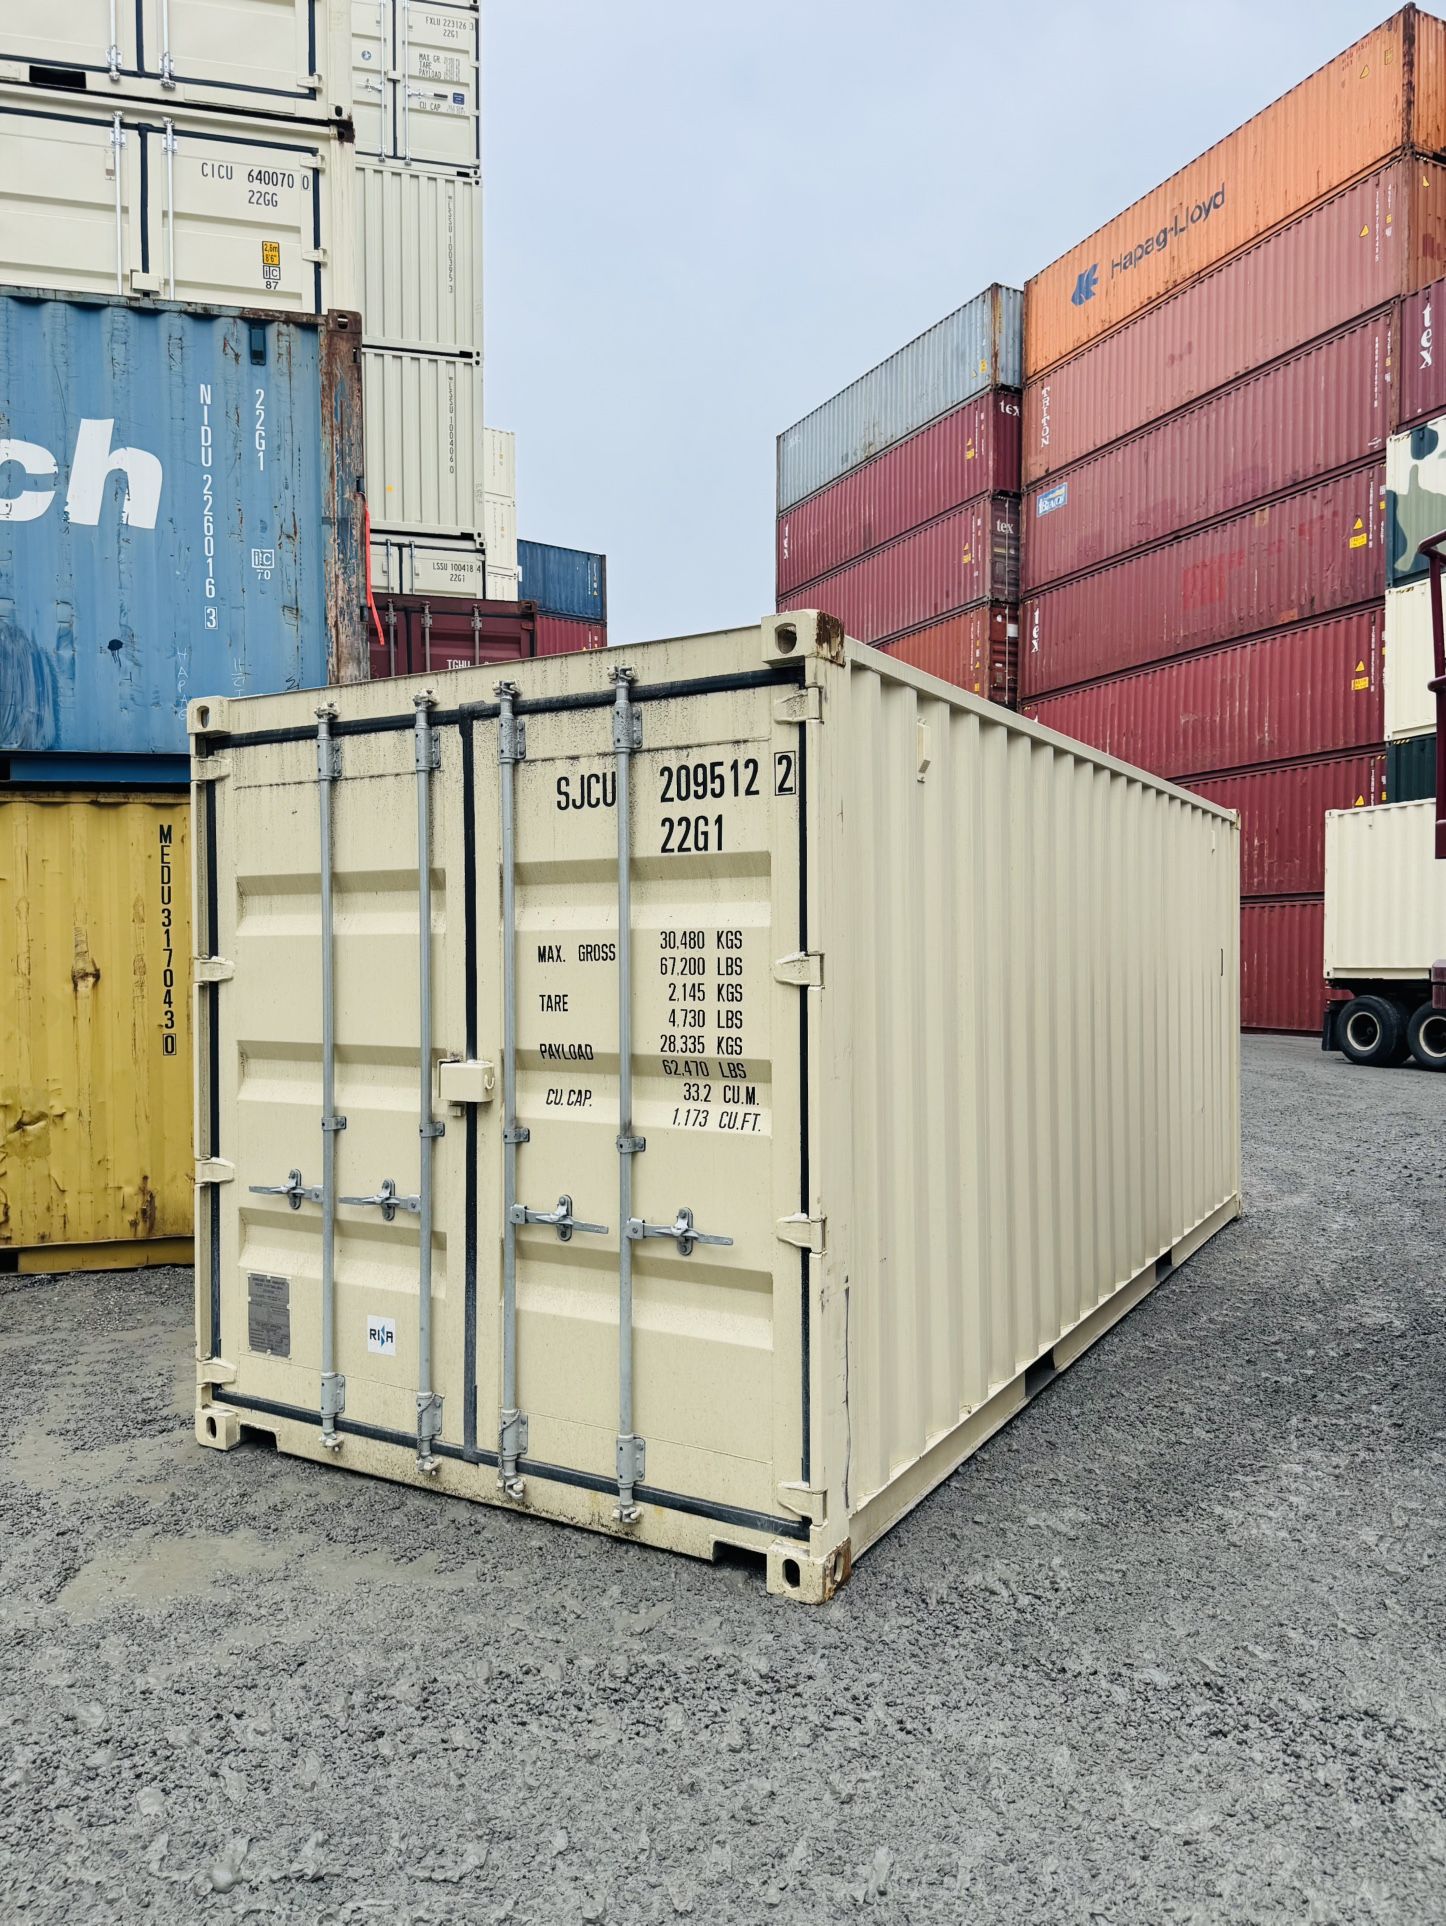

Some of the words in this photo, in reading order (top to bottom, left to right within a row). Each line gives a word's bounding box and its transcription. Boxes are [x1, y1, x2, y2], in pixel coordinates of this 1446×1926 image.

[443, 18, 467, 30] 223126
[443, 29, 458, 39] 22G1
[418, 69, 442, 80] PAYLOAD
[201, 162, 233, 180] CICU
[247, 168, 295, 189] 640070
[302, 175, 310, 190] 0
[248, 189, 278, 207] 22GG
[1111, 182, 1225, 280] Hapag-Lloyd
[265, 280, 279, 290] 87
[1420, 302, 1433, 369] tex
[1000, 399, 1020, 417] tex
[200, 384, 212, 467] NIDU
[256, 389, 265, 471] 22G1
[0, 418, 163, 529] ch
[996, 519, 1014, 534] tex
[203, 475, 215, 599] 226016
[256, 569, 271, 580] 70
[432, 562, 448, 571] LSSU
[450, 563, 474, 573] 100418
[476, 565, 481, 573] 4
[449, 573, 465, 583] 22G1
[1031, 608, 1040, 653] tex
[556, 771, 617, 811] SJCU
[659, 757, 760, 803] 209512
[777, 754, 794, 793] 2
[660, 814, 723, 853] 22G1
[159, 824, 172, 905] MEDU
[716, 930, 743, 950] KGS
[537, 944, 567, 963] MAX.
[578, 943, 617, 962] GROSS
[162, 908, 175, 1029] 317043
[717, 956, 743, 976] LBS
[717, 983, 743, 1002] KGS
[539, 994, 569, 1012] TARE
[717, 1009, 743, 1029] LBS
[165, 1034, 175, 1055] 0
[539, 1043, 594, 1061] PAYLOAD
[716, 1036, 743, 1056] KGS
[718, 1061, 747, 1079] LBS
[683, 1082, 712, 1103] 33.2
[723, 1084, 760, 1106] CU.M.
[718, 1110, 762, 1132] CU.FT.
